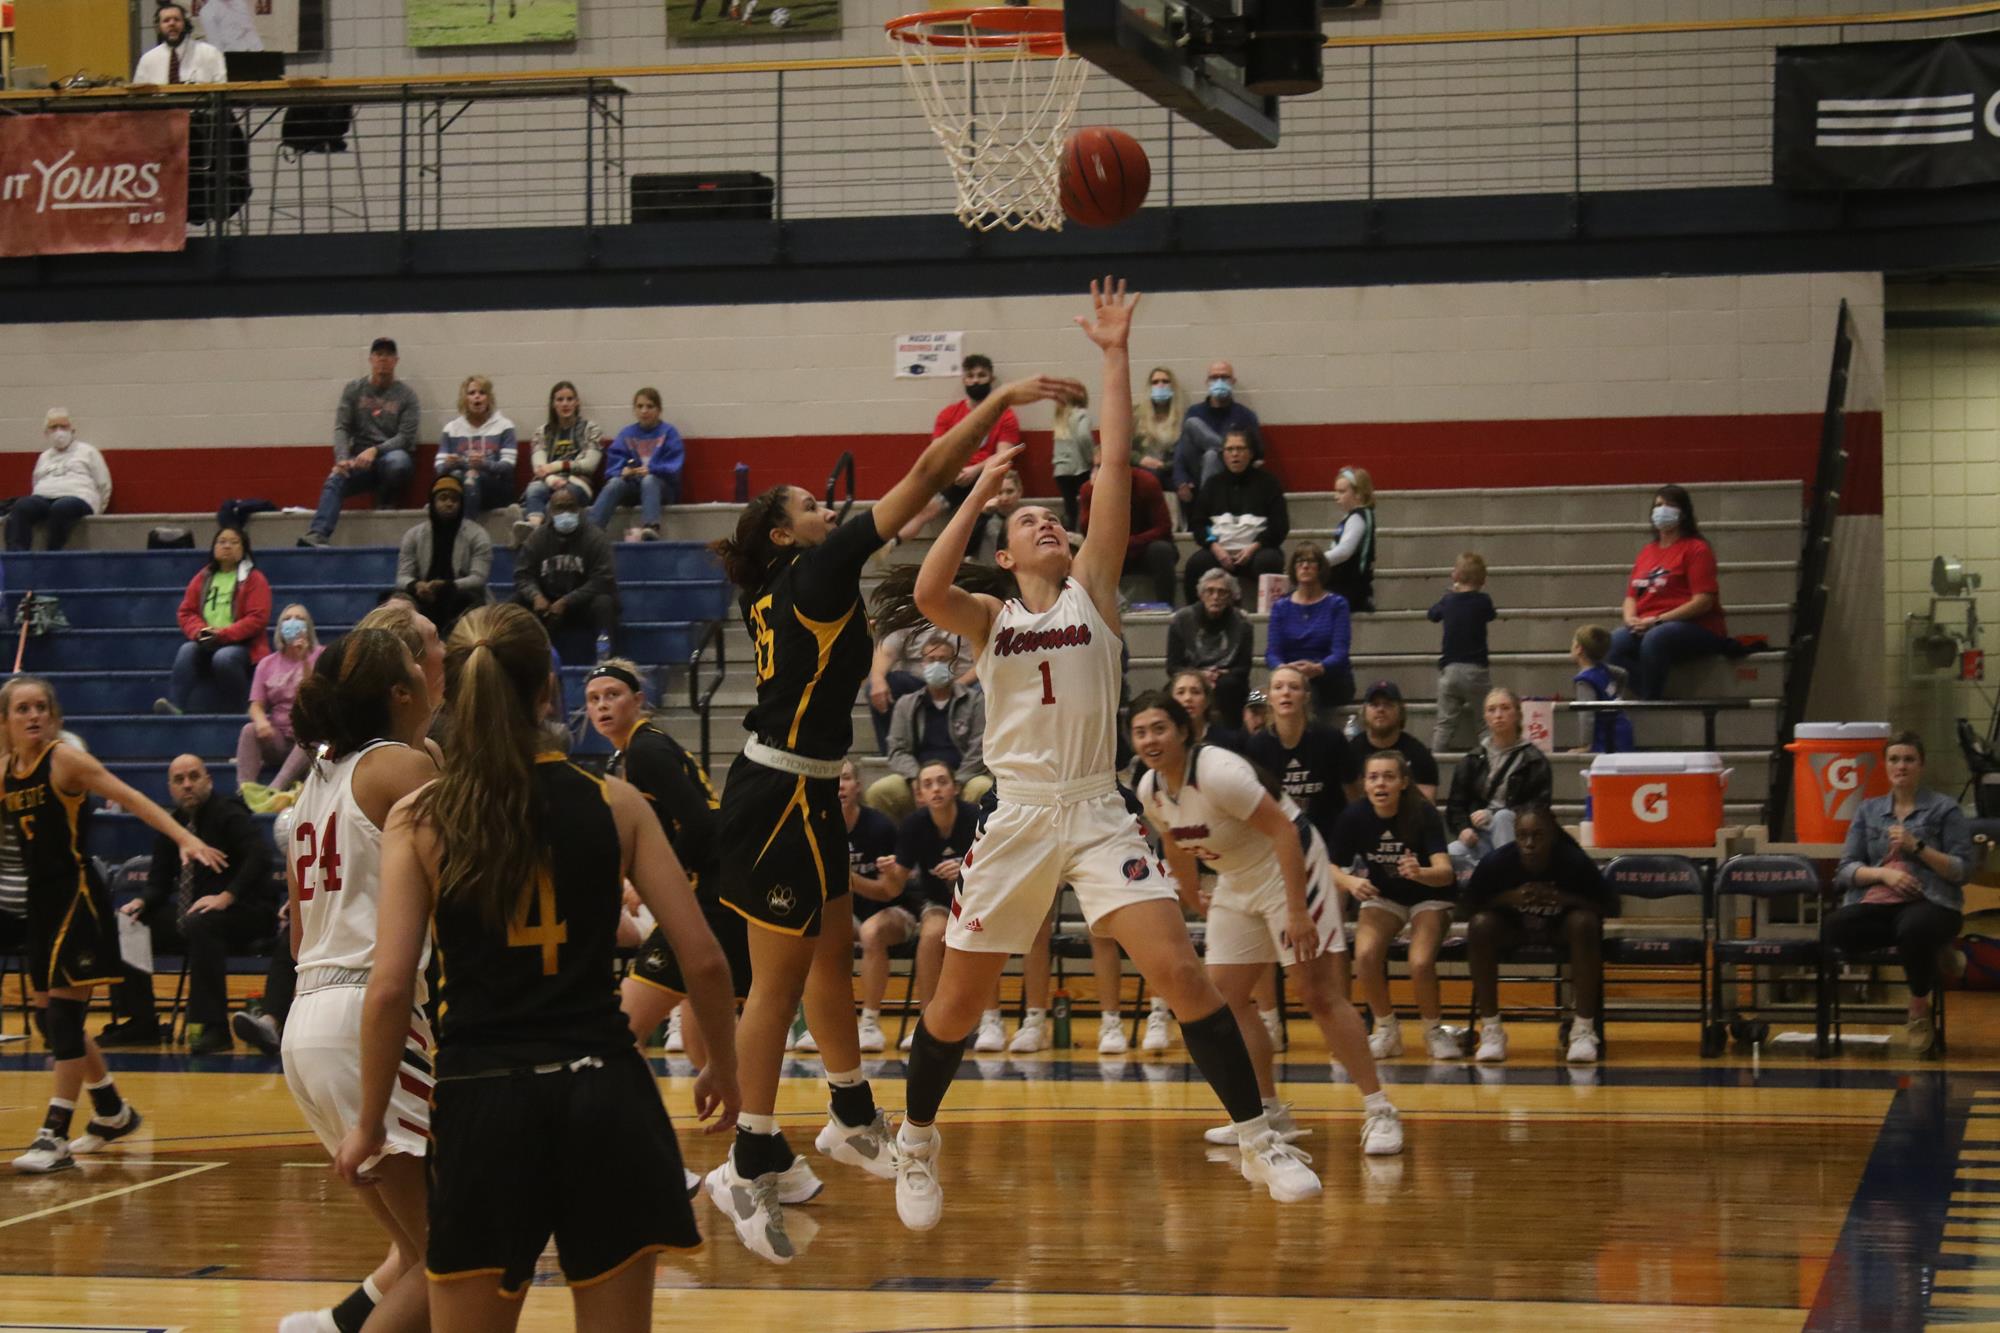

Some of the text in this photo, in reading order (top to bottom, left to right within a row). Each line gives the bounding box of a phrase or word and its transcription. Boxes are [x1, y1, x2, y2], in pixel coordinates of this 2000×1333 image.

[3, 150, 162, 213] IT YOURS
[993, 623, 1093, 657] Newman
[1038, 661, 1057, 705] 1
[1280, 782, 1324, 795] OWER
[1283, 770, 1311, 783] JET
[1827, 757, 1858, 791] G
[1631, 782, 1670, 823] G
[296, 811, 342, 901] 24
[1377, 842, 1403, 853] JET
[1731, 869, 1808, 882] NEWMAN
[507, 864, 568, 977] 4
[1634, 941, 1671, 951] JETS
